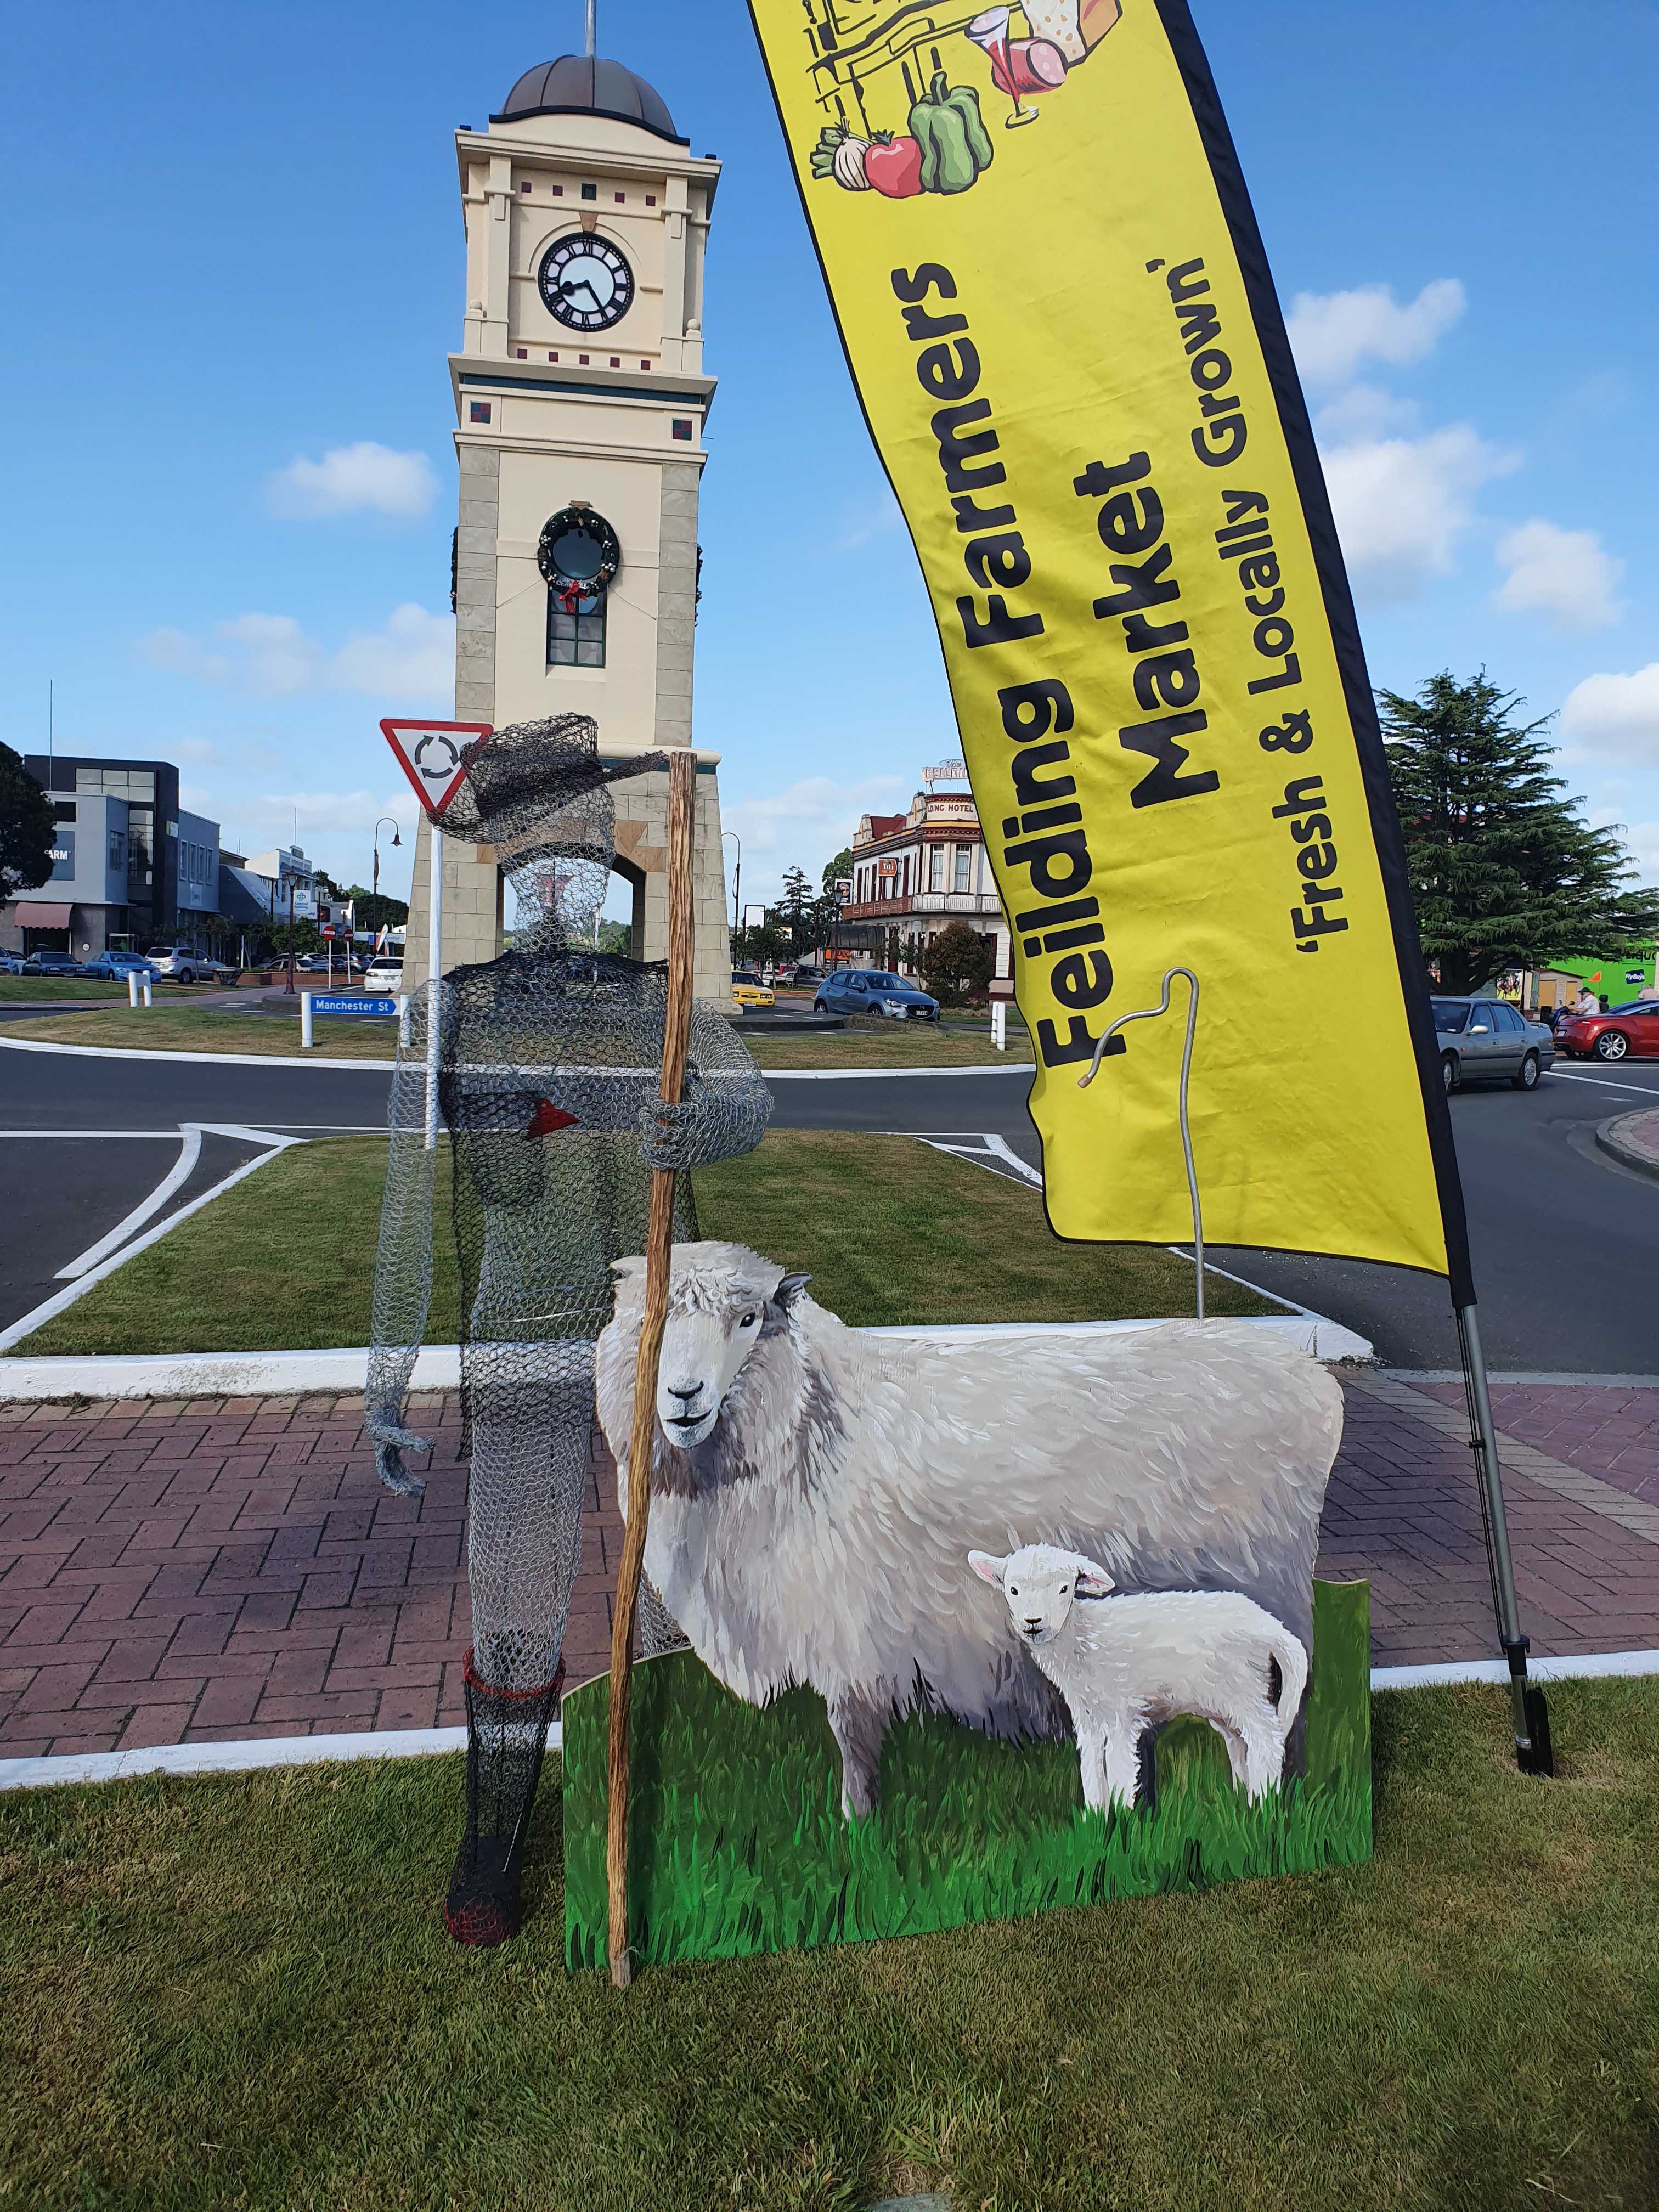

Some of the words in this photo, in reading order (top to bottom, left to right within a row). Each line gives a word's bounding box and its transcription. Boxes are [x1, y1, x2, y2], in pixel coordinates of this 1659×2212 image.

[891, 263, 1045, 648] Farmers
[1073, 452, 1220, 809] Market
[1215, 490, 1302, 695] Locally
[925, 768, 968, 778] FEILDI
[1259, 709, 1313, 753] &
[948, 804, 974, 812] HOTEL
[997, 679, 1126, 1068] Feilding
[315, 1000, 374, 1011] Manchester
[377, 1002, 389, 1011] St
